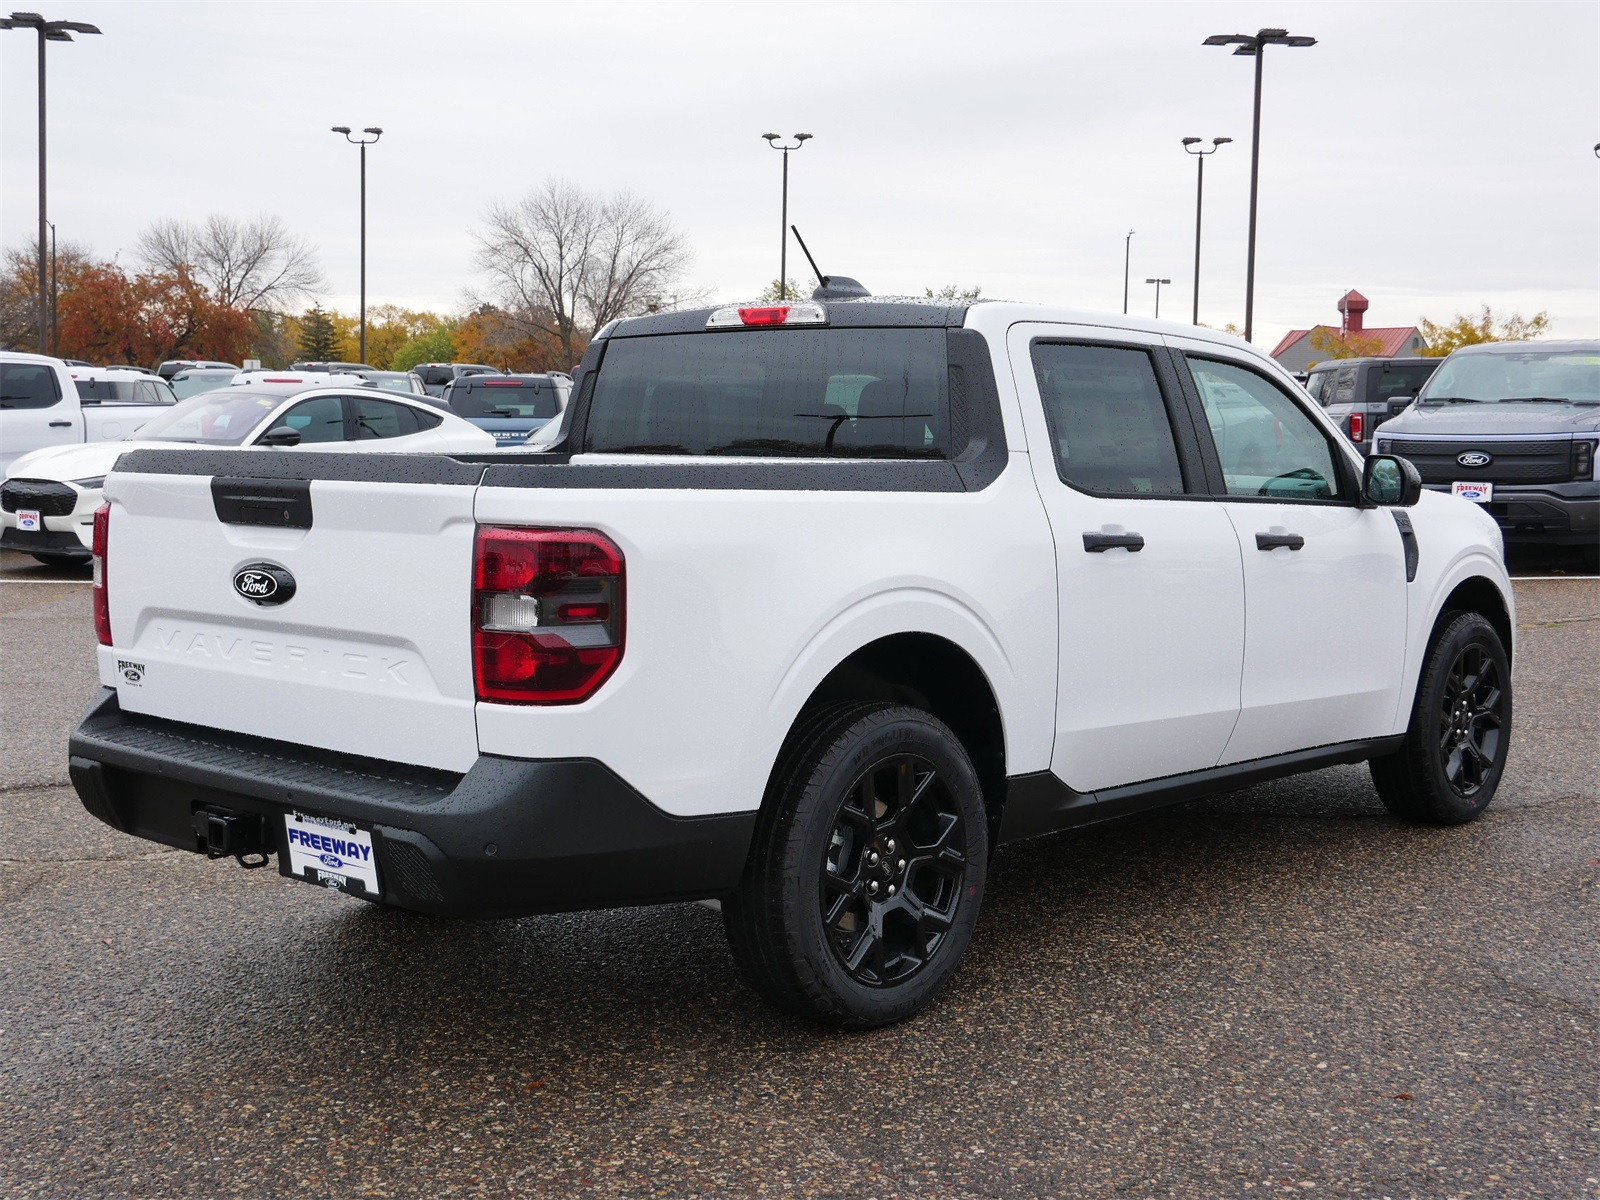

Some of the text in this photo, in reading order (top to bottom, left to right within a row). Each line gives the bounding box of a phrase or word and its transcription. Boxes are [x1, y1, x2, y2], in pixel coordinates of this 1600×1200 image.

[1462, 454, 1484, 465] Ford
[1456, 485, 1488, 495] FREEWAY
[241, 573, 269, 594] Ford
[155, 627, 409, 686] MAVERICK
[118, 660, 146, 676] FREEWAY
[288, 827, 371, 862] FREEWAY
[323, 854, 340, 868] Ford
